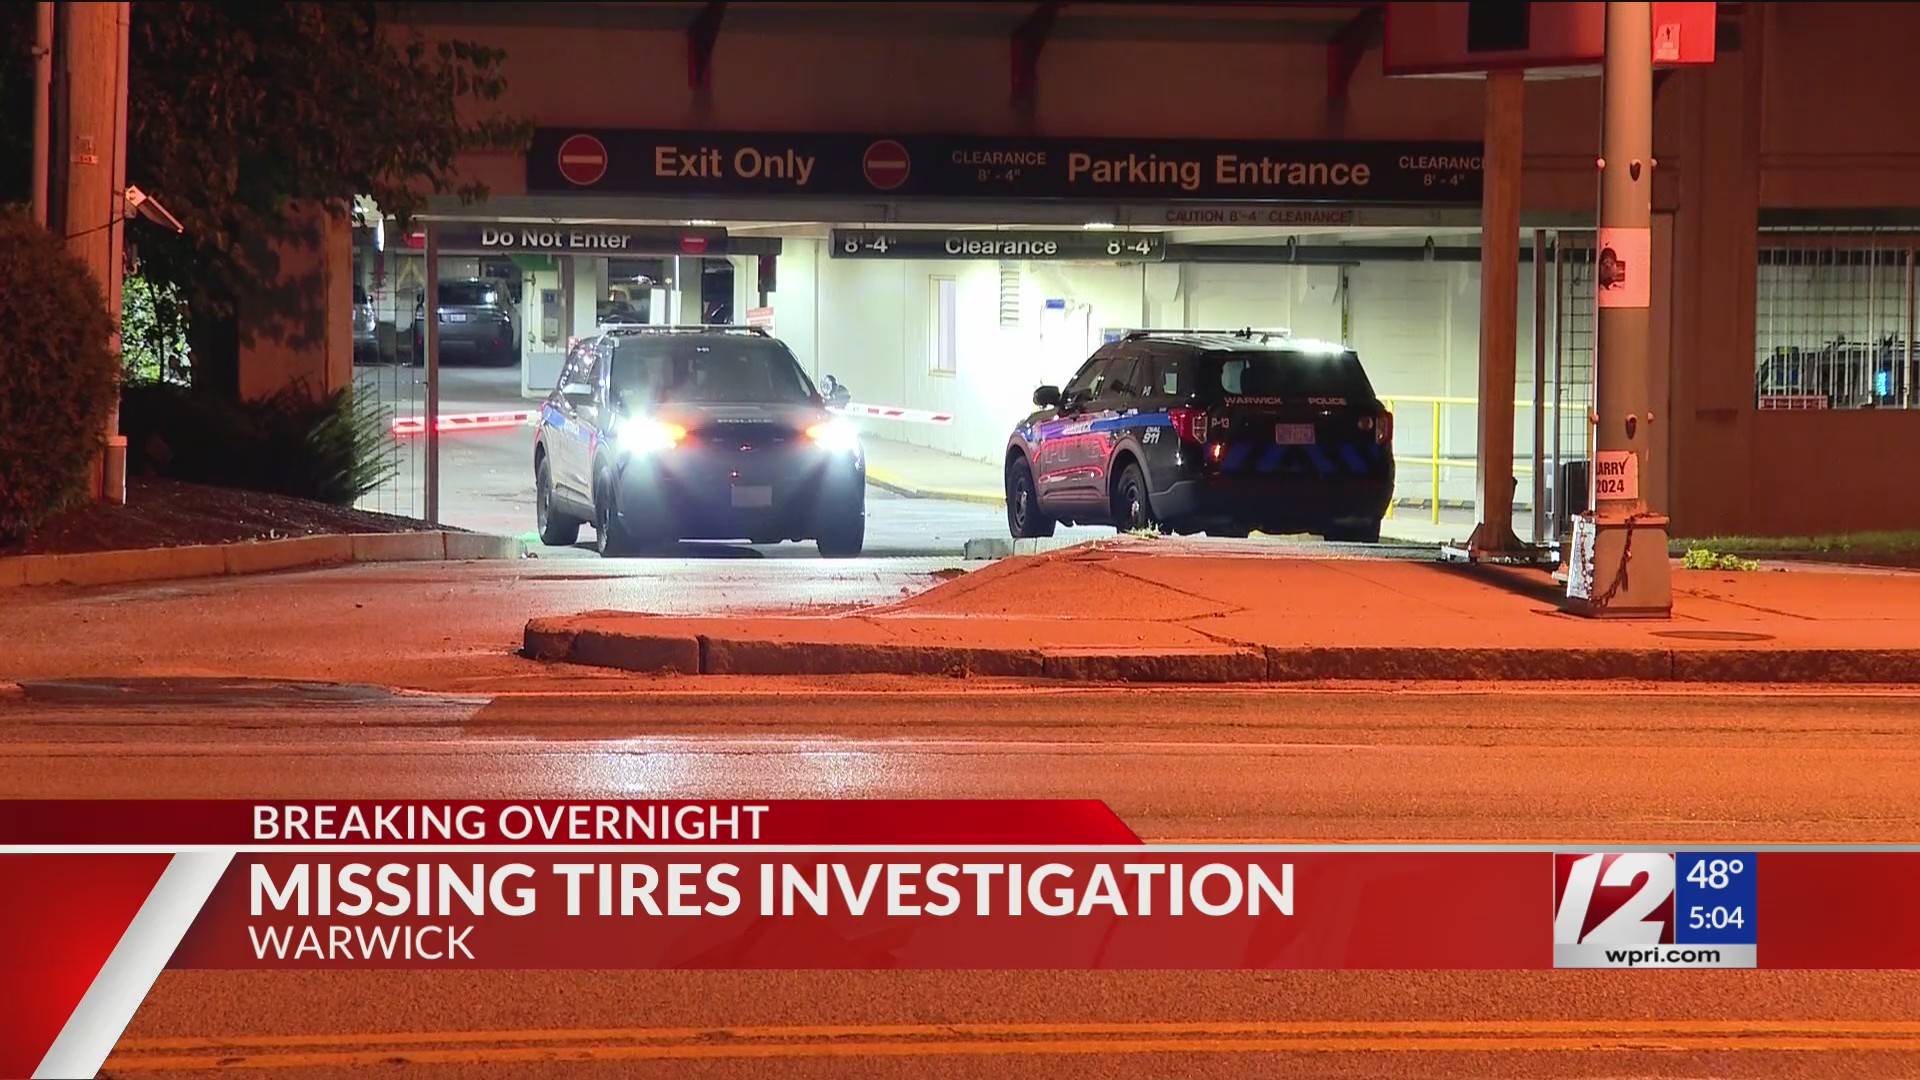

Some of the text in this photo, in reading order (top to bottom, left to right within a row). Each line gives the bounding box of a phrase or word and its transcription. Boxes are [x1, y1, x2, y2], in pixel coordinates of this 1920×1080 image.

[951, 150, 1047, 165] CLEARANCE
[655, 146, 815, 185] Exit Only
[1068, 153, 1371, 190] Parking Entrance
[1165, 210, 1223, 223] CAUTION
[1269, 210, 1349, 223] CLEARANCE
[482, 228, 632, 249] Do Not Enter
[945, 236, 1058, 255] Clearance
[1224, 396, 1348, 406] WARWICK POLICE
[1211, 417, 1230, 429] P-13
[1142, 432, 1160, 444] 911
[1596, 479, 1625, 493] 2024
